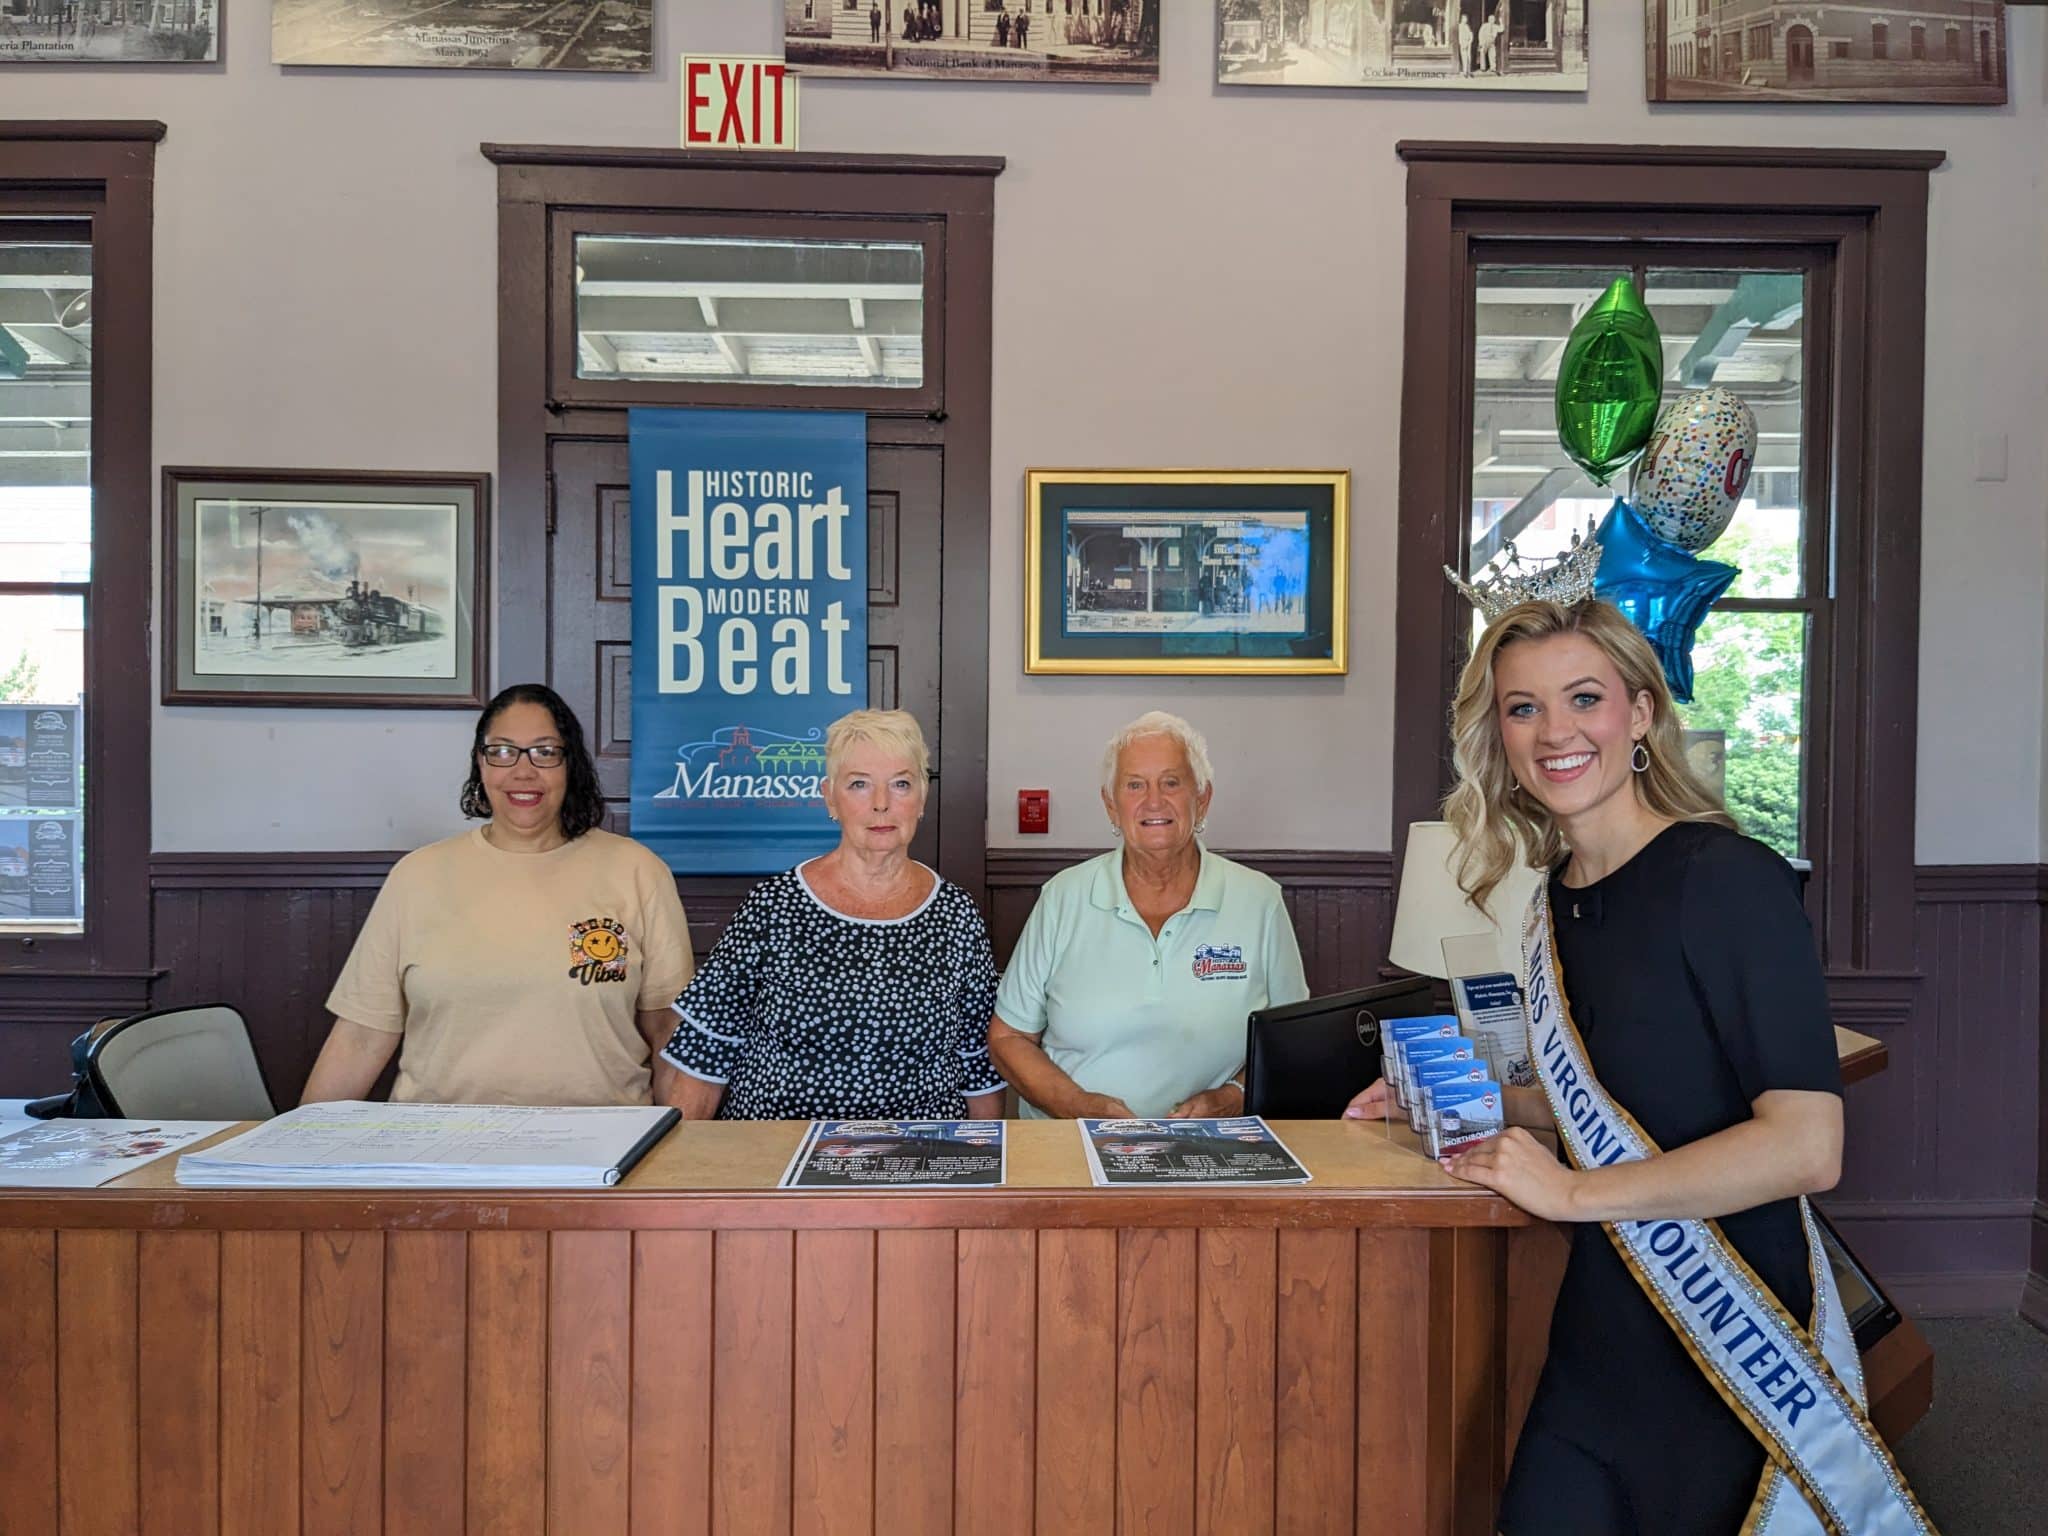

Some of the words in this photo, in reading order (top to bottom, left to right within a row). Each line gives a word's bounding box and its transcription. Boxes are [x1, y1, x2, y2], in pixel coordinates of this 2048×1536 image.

[21, 40, 75, 51] Plantation
[415, 32, 462, 44] Manassas
[463, 33, 510, 46] Junction
[434, 47, 465, 57] March
[904, 57, 949, 69] National
[951, 58, 978, 69] Bank
[981, 58, 992, 69] of
[1397, 68, 1448, 80] Pharmacy
[687, 62, 785, 145] EXIT
[706, 470, 814, 499] HISTORIC
[655, 469, 851, 581] Heart
[707, 588, 809, 615] MODERN
[657, 585, 852, 695] Beat
[568, 959, 627, 986] Vibes
[1529, 940, 1549, 1025] MISS
[1543, 1024, 1627, 1167] VIRGINI
[1636, 1219, 1817, 1429] OLUNTEER
